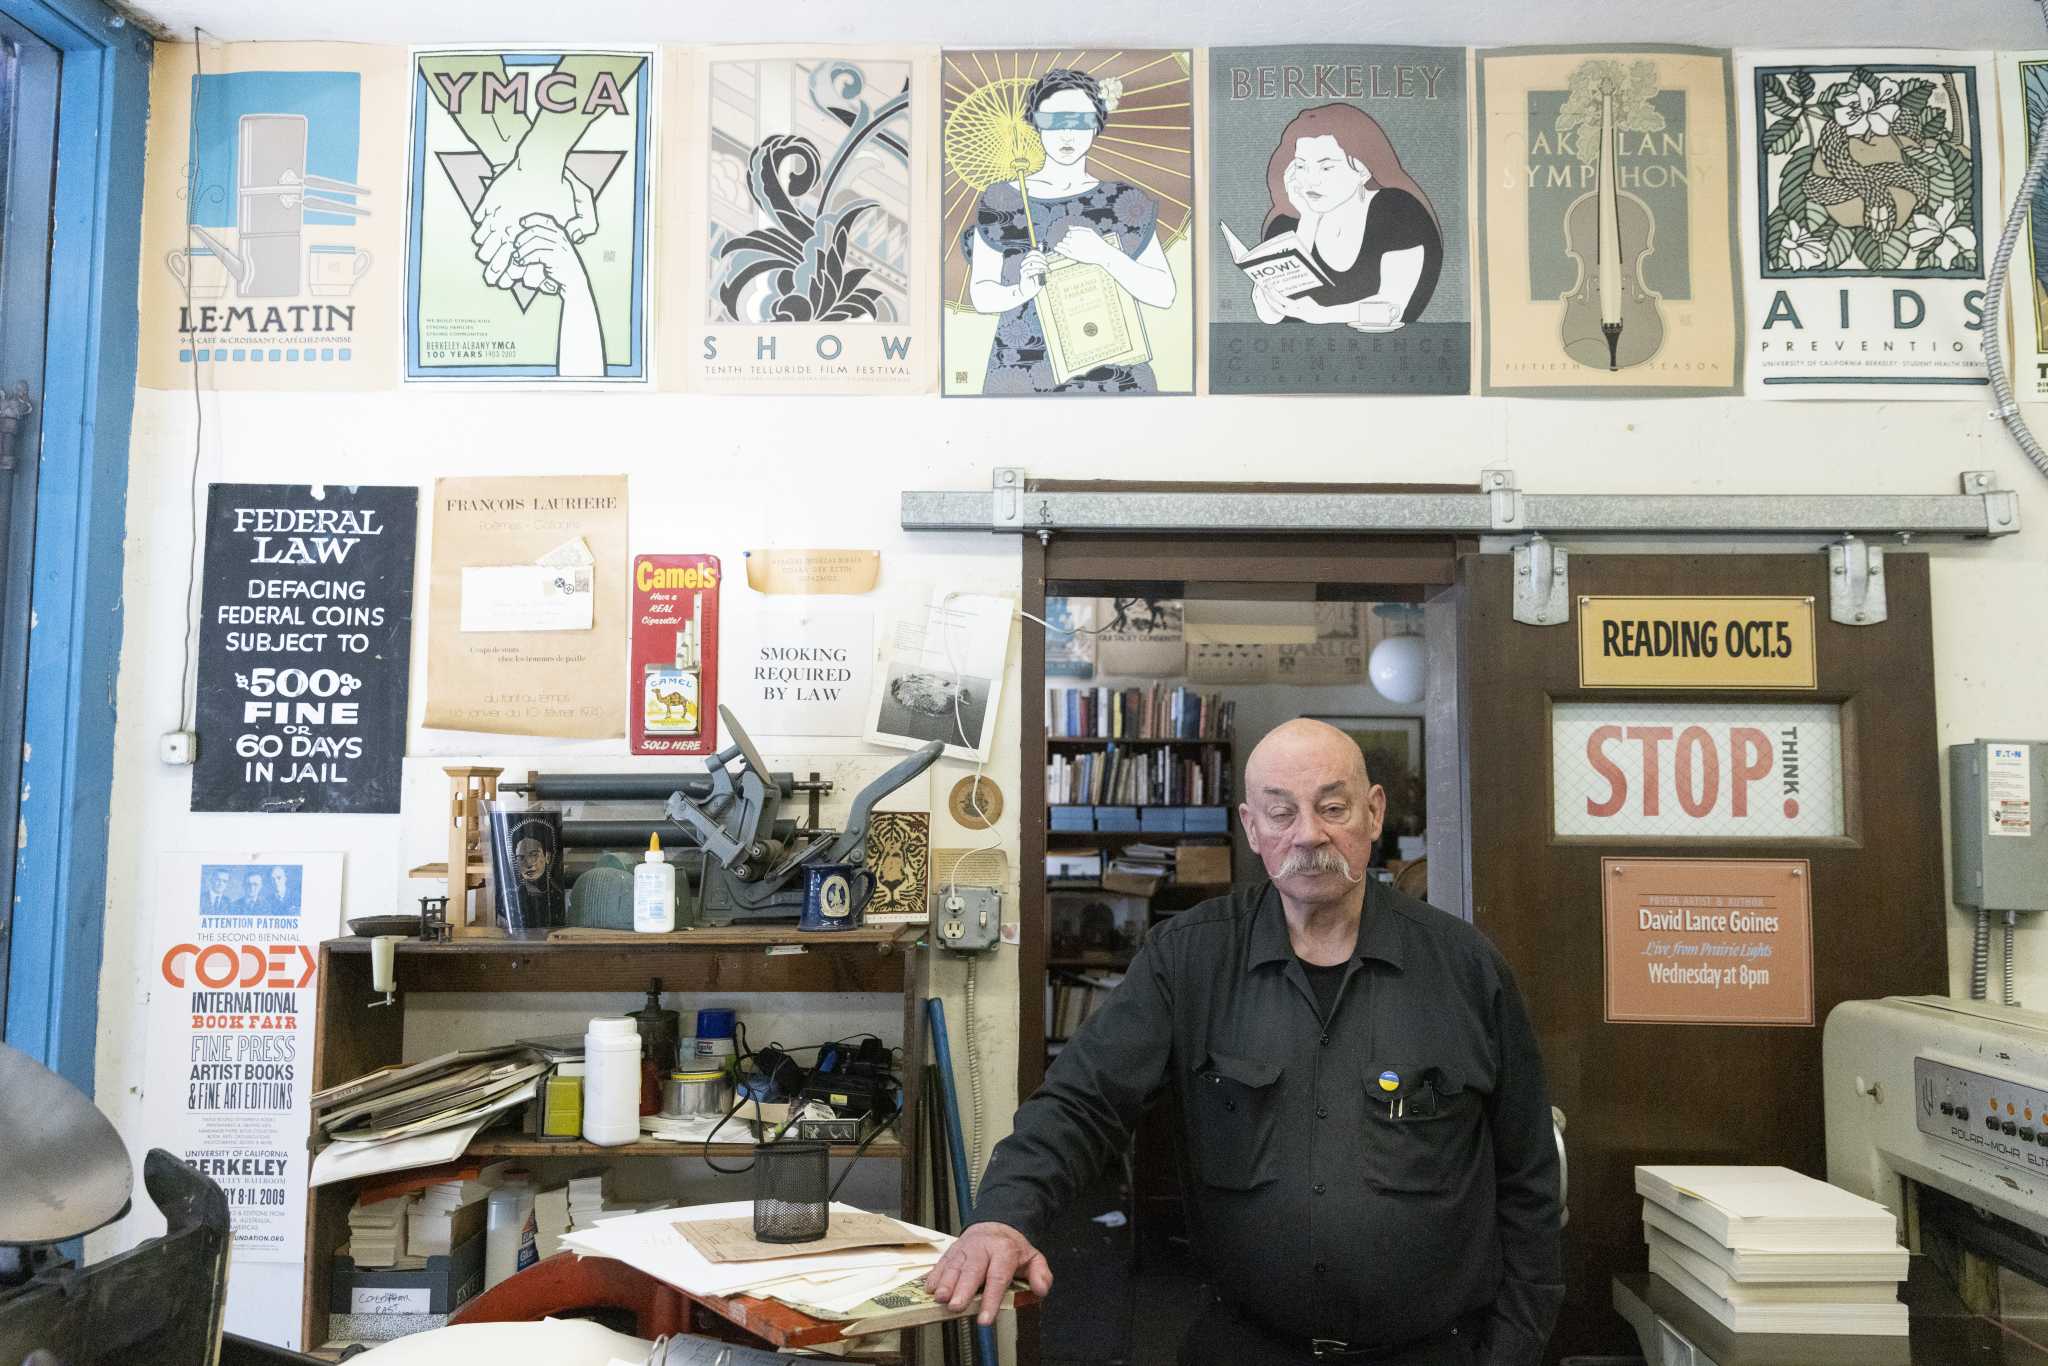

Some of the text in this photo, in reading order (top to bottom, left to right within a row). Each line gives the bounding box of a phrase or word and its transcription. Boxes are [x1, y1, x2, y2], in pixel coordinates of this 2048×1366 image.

[1230, 63, 1445, 100] BERKELEY
[433, 71, 630, 115] YMCA
[1251, 260, 1300, 279] HOWL
[1762, 289, 1986, 331] AIDS
[427, 351, 445, 359] 100
[491, 340, 516, 350] YMCA
[703, 335, 912, 360] SHOW
[705, 366, 911, 375] TENTH TELLURIDE FILM FESTIVAL
[1649, 362, 1720, 371] SEASON
[1762, 360, 1804, 368] UNIVERSITY
[1819, 360, 1862, 368] CALIFORNIA
[1902, 360, 1932, 368] STUDENT
[233, 508, 384, 536] FEDERAL
[250, 536, 361, 564] LAW
[637, 560, 717, 592] Camels
[248, 579, 366, 600] DEFACING
[650, 592, 671, 601] Have
[217, 605, 385, 627] FEDERAL COINS
[649, 604, 674, 613] REAL
[225, 632, 370, 653] SUBJECT TO
[1602, 619, 1718, 657] READING
[760, 647, 847, 662] SMOKING
[650, 678, 692, 688] CAMEL
[754, 667, 851, 682] REQUIRED
[764, 687, 841, 701] BY LAW
[243, 701, 359, 724] FINE
[283, 725, 312, 735] OR
[236, 734, 362, 758] 60 DAYS
[641, 740, 701, 751] SOLD HERE
[1586, 725, 1774, 818] STOP
[1782, 727, 1799, 795] THINK
[245, 761, 348, 783] IN JAIL
[201, 918, 298, 929] ATTENTION PATRONS
[1639, 909, 1779, 932] David Lance Goines
[198, 933, 301, 942] THE SECOND BIENNIAL
[1648, 963, 1769, 989] Wednesday at 8pm
[192, 992, 298, 1013] INTERNATIONAL
[192, 1015, 297, 1029] BOOK FAIR
[191, 1035, 295, 1062] FINE PRESS
[190, 1064, 294, 1080] ARTIST BOOKS
[188, 1083, 196, 1109] &
[224, 1082, 243, 1109] ART
[1951, 1126, 2020, 1158] POLAR-MOHR
[260, 1188, 285, 1206] 2009
